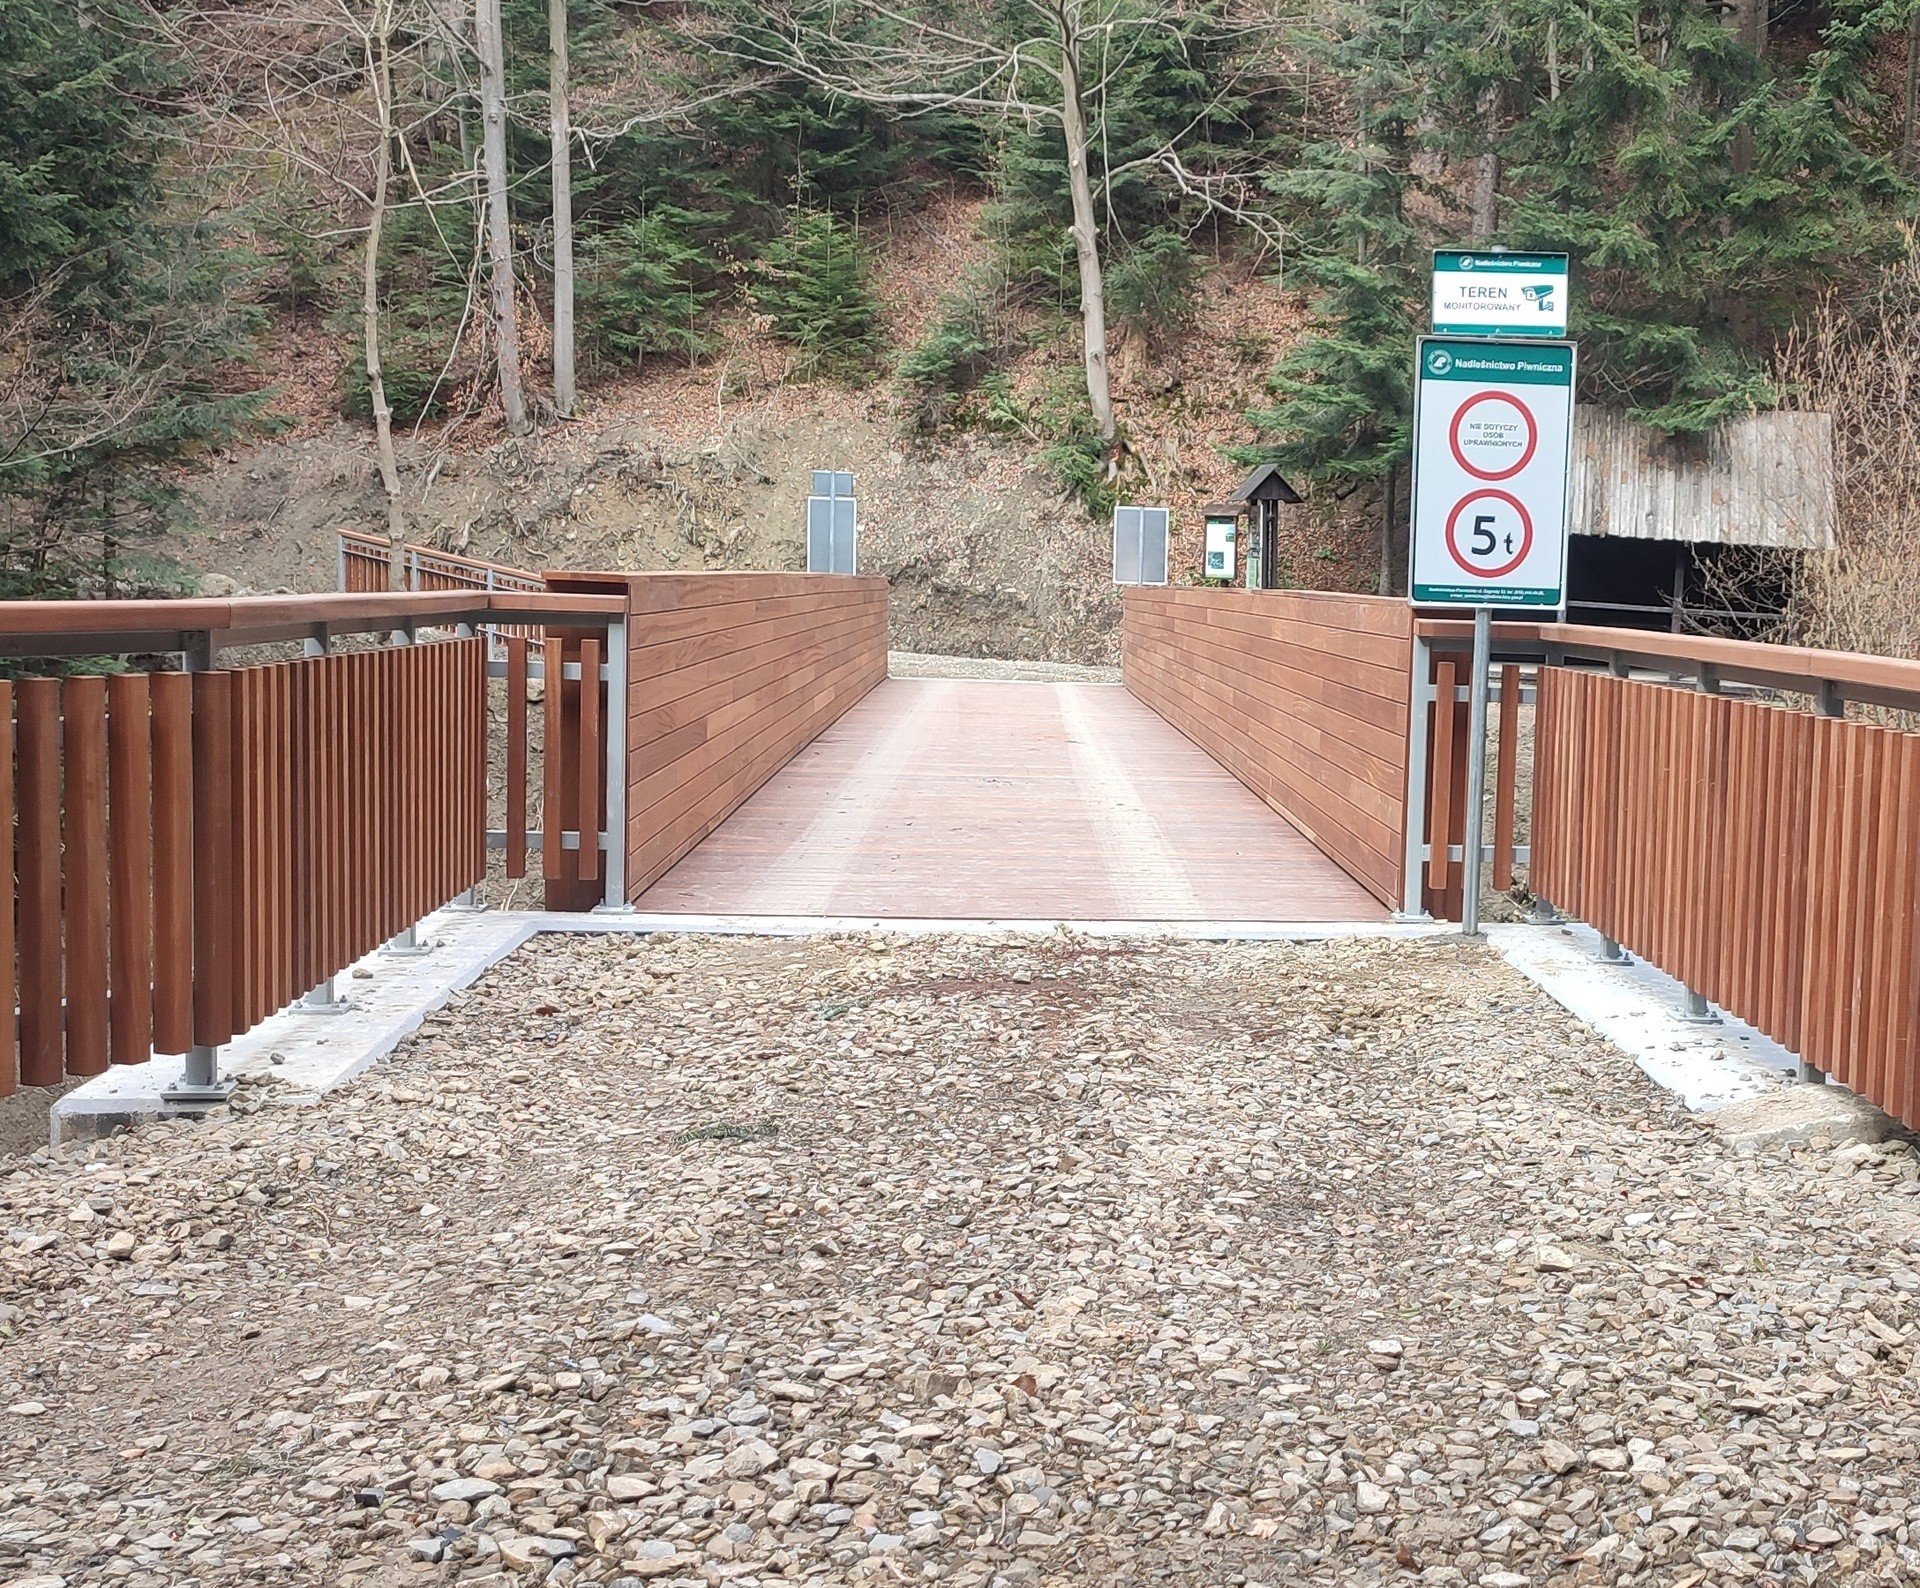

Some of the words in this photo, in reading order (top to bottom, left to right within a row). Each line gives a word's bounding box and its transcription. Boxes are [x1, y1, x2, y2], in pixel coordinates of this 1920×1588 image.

[1459, 286, 1508, 298] TEREN
[1443, 302, 1521, 311] MONITOROWANY
[1454, 358, 1516, 370] Nadleśnictwo
[1516, 361, 1563, 372] Piwniczna
[1464, 439, 1522, 447] UPRAWNIONYCH
[1471, 515, 1497, 556] 5
[1503, 531, 1514, 555] t
